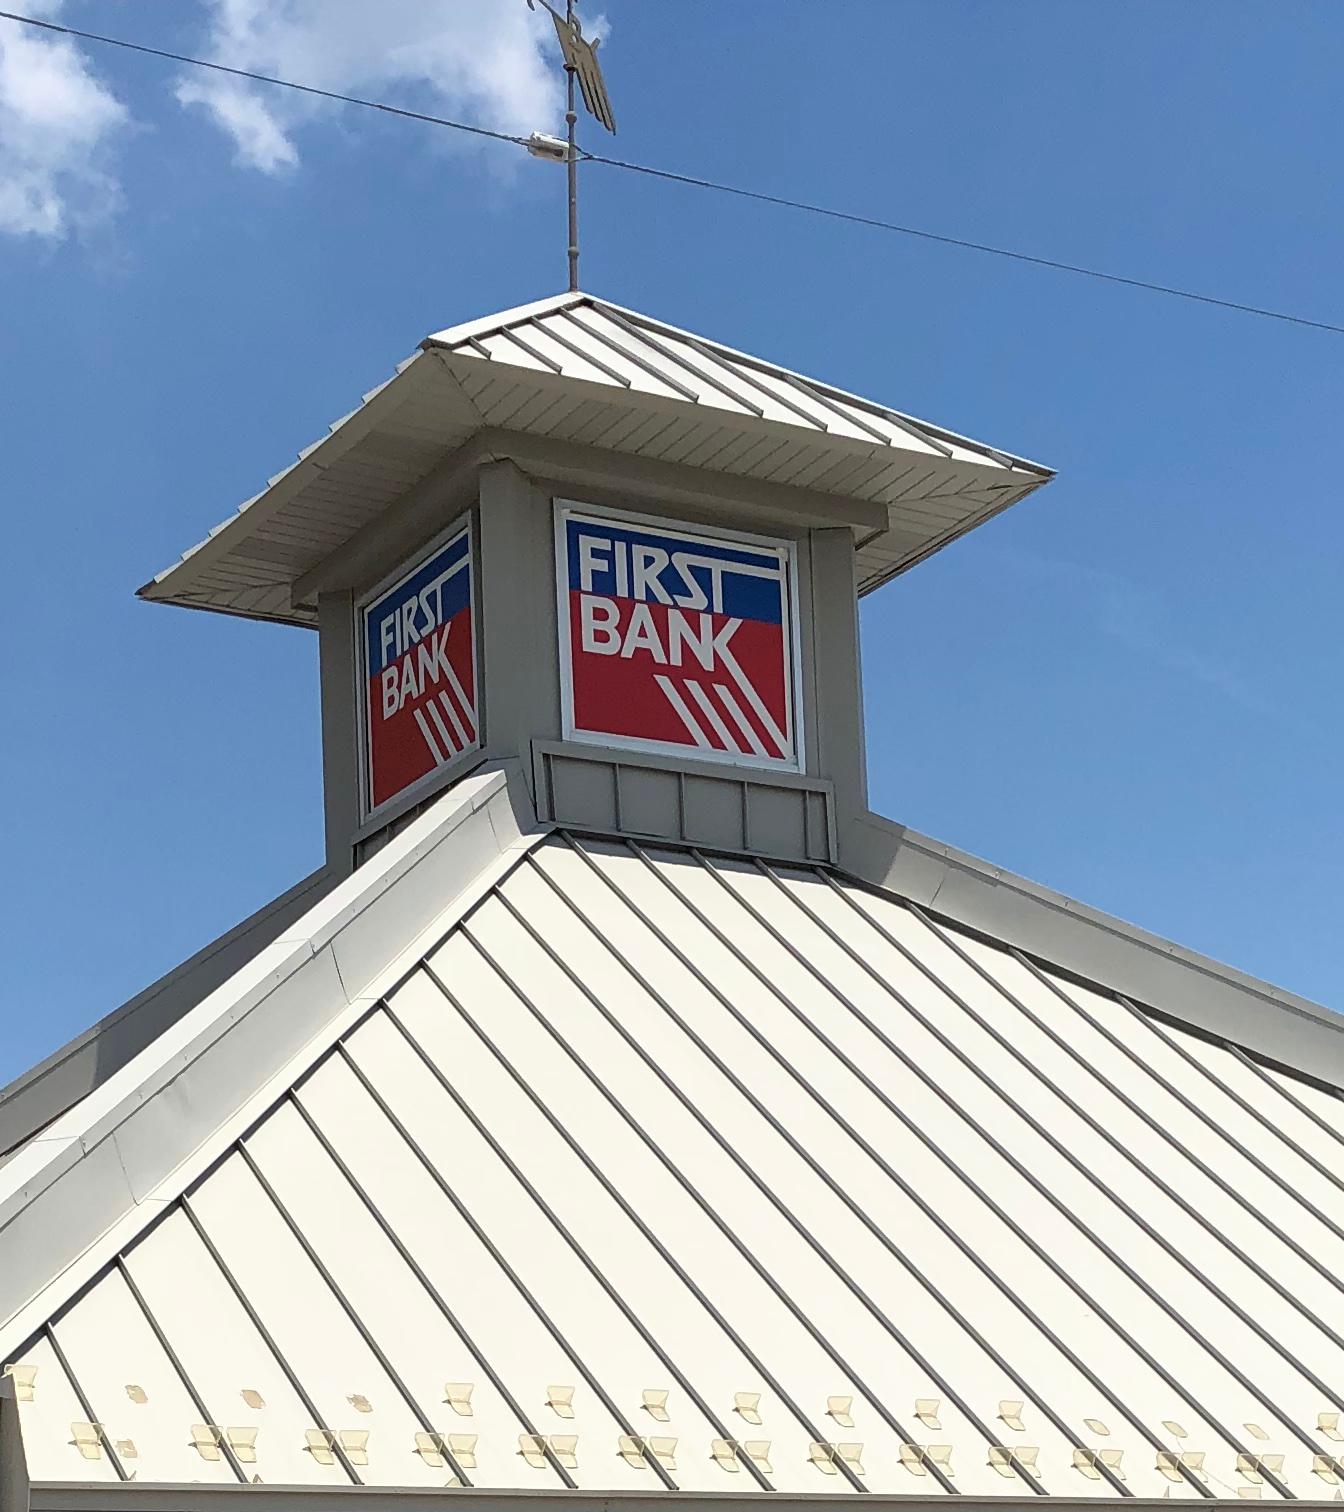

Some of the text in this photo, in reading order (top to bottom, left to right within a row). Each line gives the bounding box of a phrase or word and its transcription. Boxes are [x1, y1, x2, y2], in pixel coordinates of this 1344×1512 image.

[380, 554, 471, 666] FIRST
[579, 534, 780, 613] FIRST
[380, 622, 453, 720] BANK
